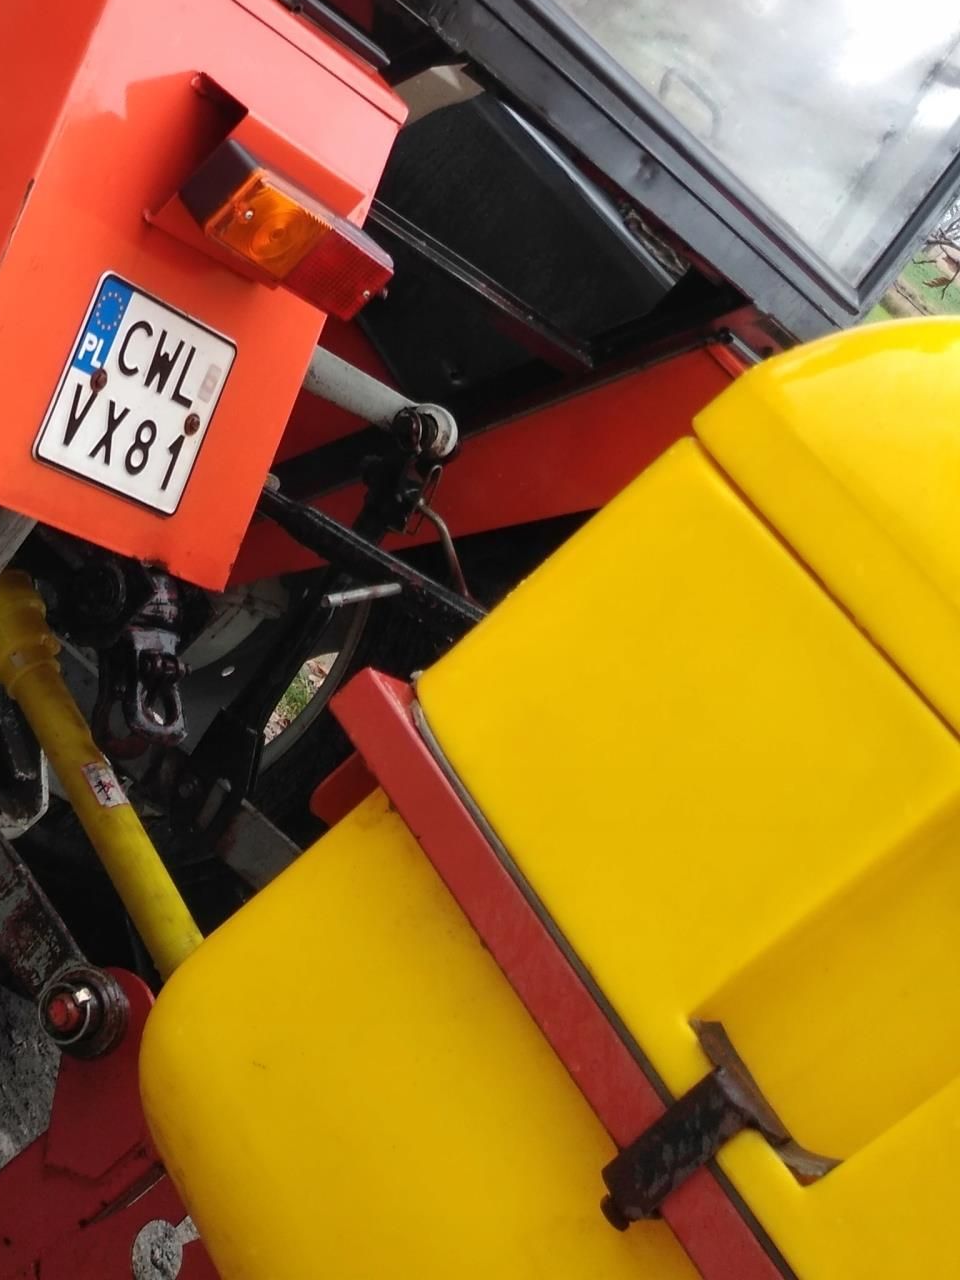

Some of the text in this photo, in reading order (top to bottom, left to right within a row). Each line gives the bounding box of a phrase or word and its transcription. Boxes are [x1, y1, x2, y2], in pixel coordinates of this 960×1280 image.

[77, 332, 105, 369] PL
[117, 320, 197, 409] CWL
[62, 382, 186, 492] VX81
